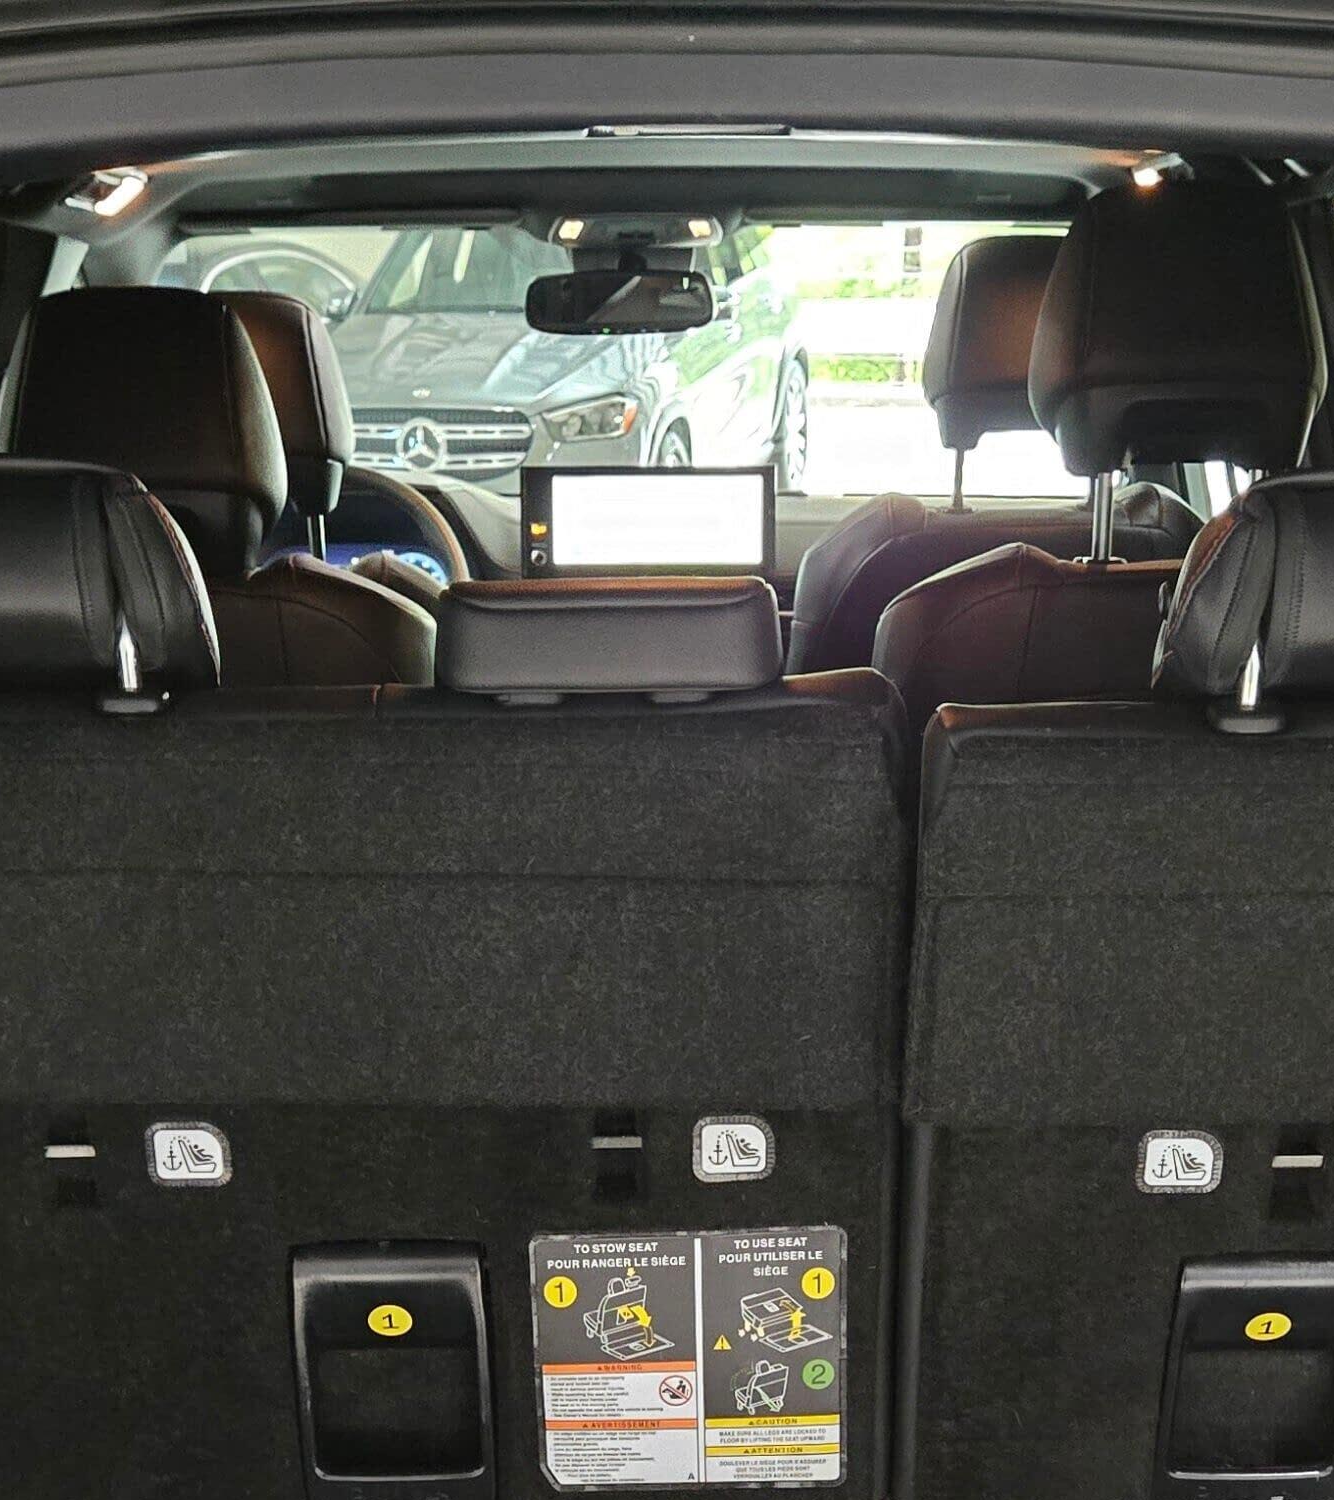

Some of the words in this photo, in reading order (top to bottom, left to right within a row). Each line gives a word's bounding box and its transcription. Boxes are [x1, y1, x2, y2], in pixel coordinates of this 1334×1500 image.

[573, 1244, 590, 1254] TO
[592, 1243, 625, 1254] STOW
[628, 1242, 658, 1252] SEAT
[734, 1240, 749, 1250] TO
[752, 1238, 776, 1248] USE
[778, 1237, 807, 1247] SEAT
[547, 1259, 580, 1269] POUR
[582, 1258, 631, 1268] RANGER
[634, 1257, 648, 1267] LE
[651, 1255, 686, 1266] SIÈGE
[718, 1252, 751, 1264] POUR
[753, 1251, 806, 1261] UTILISER
[808, 1250, 823, 1260] LE
[753, 1264, 789, 1276] SIÈGE
[813, 1273, 821, 1293] 1
[554, 1282, 563, 1303] 1
[381, 1313, 399, 1329] 1
[1257, 1320, 1276, 1335] 1
[811, 1363, 826, 1385] 2
[755, 1418, 798, 1426] CAUTION
